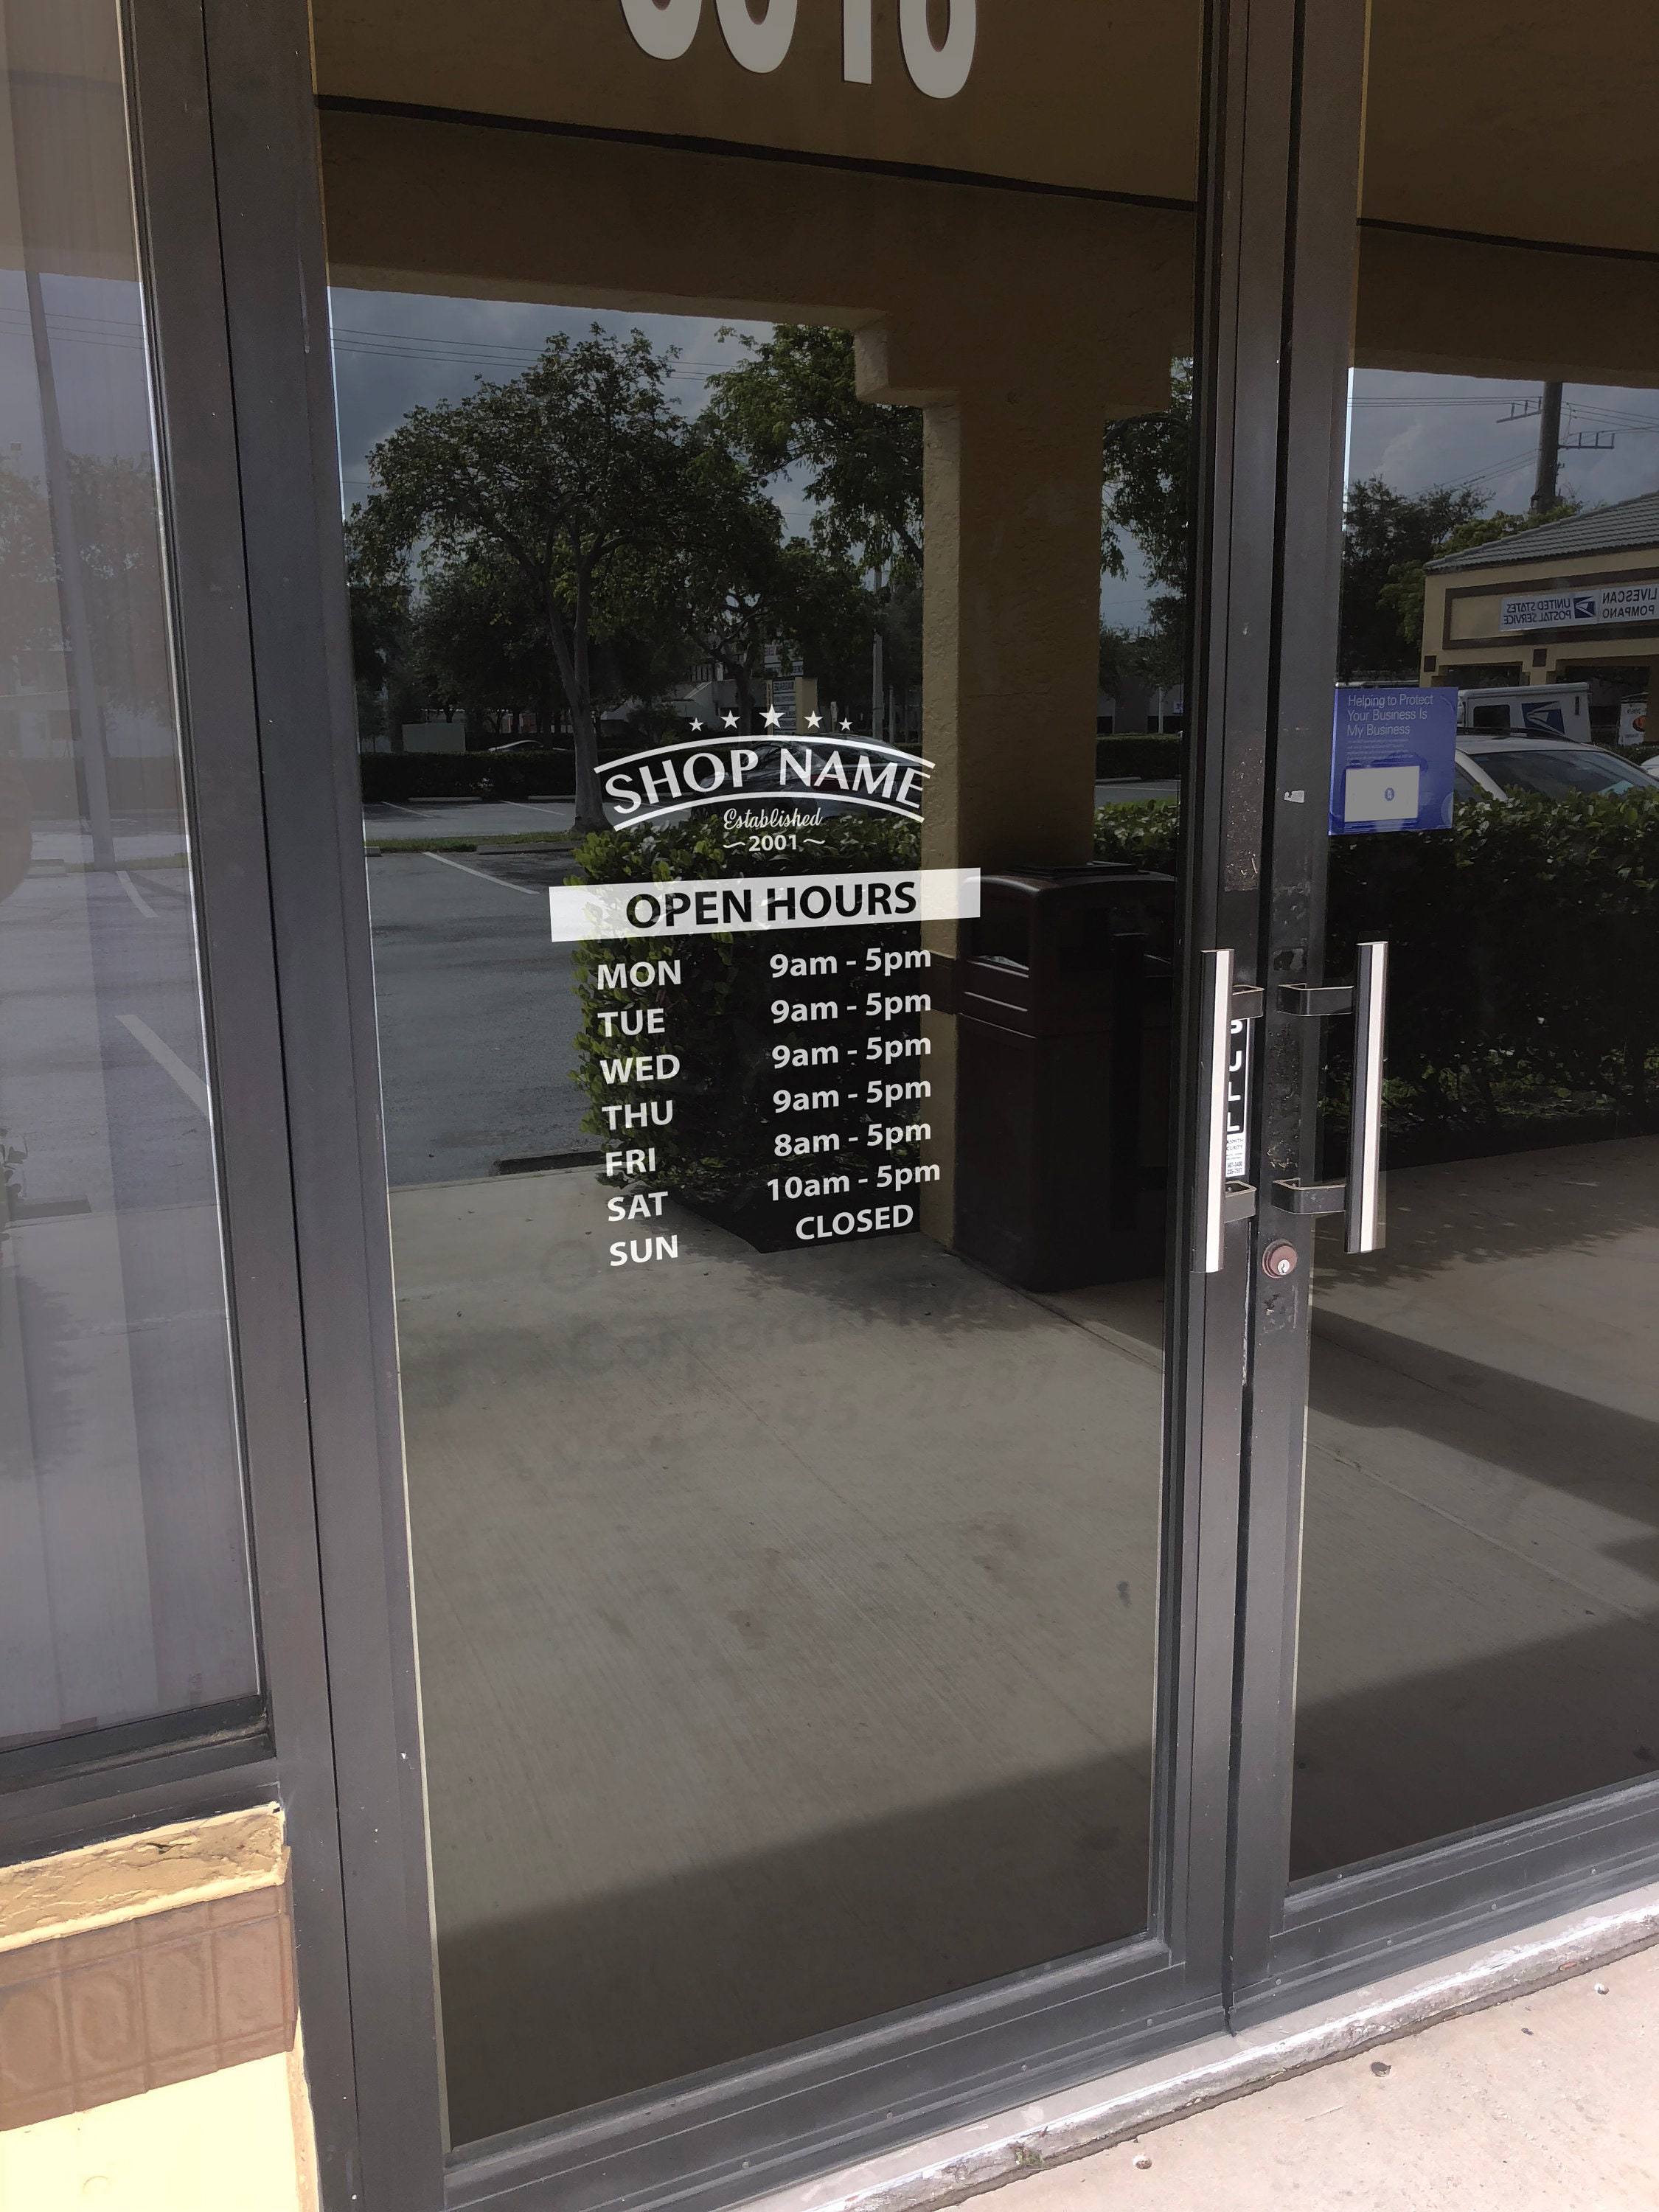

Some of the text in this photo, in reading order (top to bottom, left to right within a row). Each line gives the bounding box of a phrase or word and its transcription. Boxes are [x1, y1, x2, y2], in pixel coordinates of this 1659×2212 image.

[1347, 708, 1427, 721] Your Business Is
[1348, 693, 1433, 709] Helping to Protect
[1346, 723, 1411, 738] My Business
[605, 748, 931, 814] SHOP NAME
[723, 807, 823, 830] Established
[749, 835, 796, 851] 2001
[627, 882, 916, 928] OPEN HOURS
[598, 960, 680, 990] MON
[771, 954, 837, 978] 9am
[866, 948, 931, 975] 5pm
[598, 1009, 664, 1037] TUE
[771, 1001, 838, 1023] 9am
[866, 993, 931, 1020] 5pm
[773, 1046, 838, 1068] 9am
[866, 1037, 931, 1064] 5pm
[600, 1055, 679, 1084] WED
[773, 1091, 838, 1113] 9am
[867, 1081, 931, 1107] 5pm
[602, 1101, 672, 1130] THU
[775, 1134, 839, 1156] 8am
[867, 1124, 931, 1150] 5pm
[606, 1148, 655, 1176] FRI
[768, 1176, 849, 1200] 10am
[877, 1164, 939, 1191] 5pm
[608, 1192, 667, 1221] SAT
[796, 1205, 913, 1239] CLOSED
[610, 1235, 678, 1266] SUN
